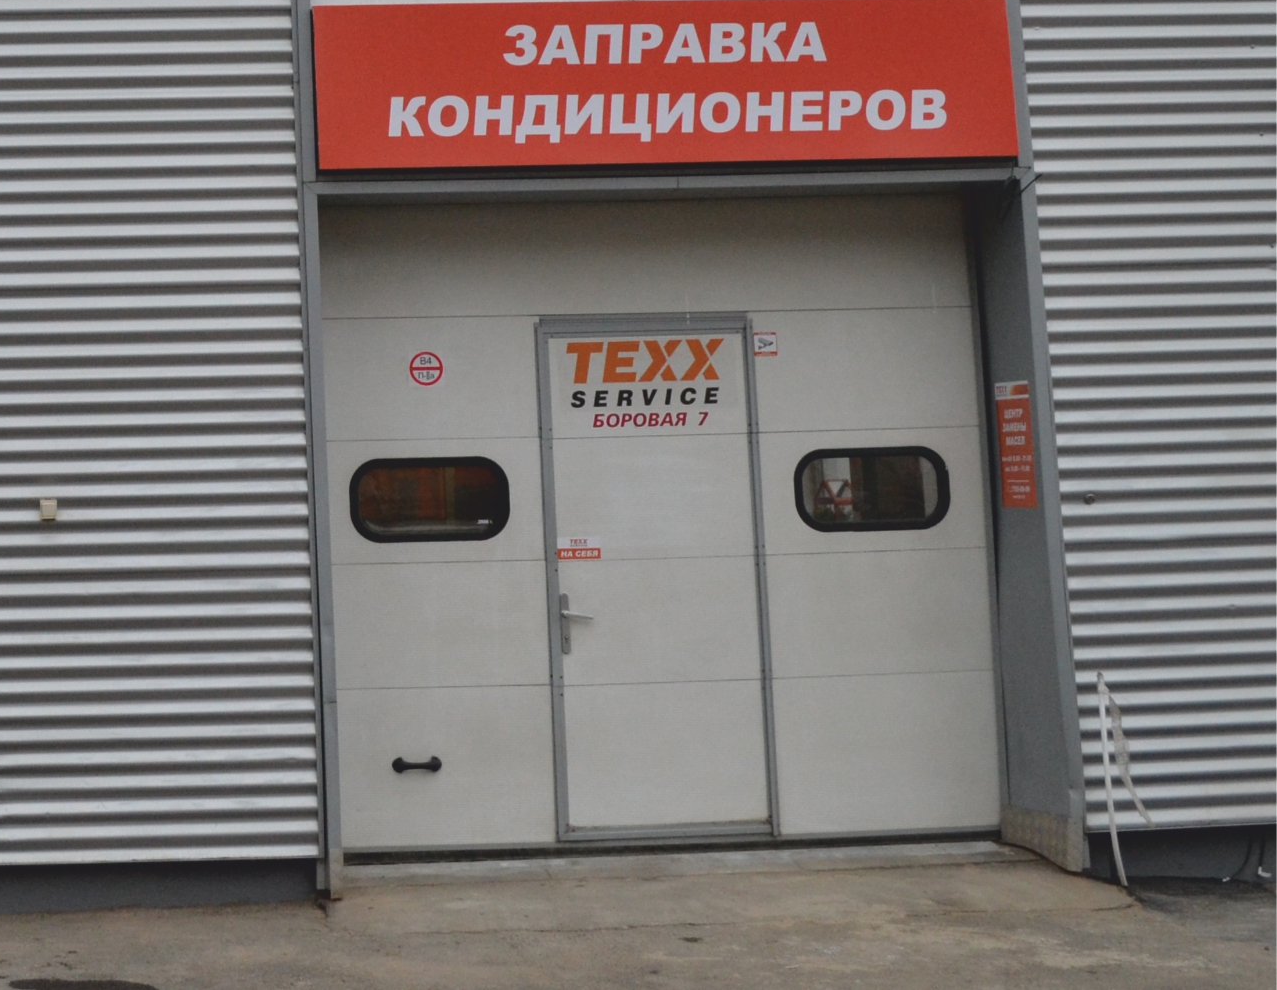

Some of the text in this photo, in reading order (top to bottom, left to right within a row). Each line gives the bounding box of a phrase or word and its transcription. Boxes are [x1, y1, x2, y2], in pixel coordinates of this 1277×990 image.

[503, 21, 827, 67] ЗАПРАВКА
[388, 89, 947, 144] КОНДИЦИОНЕРОВ
[566, 338, 724, 384] TEXX
[571, 387, 719, 408] SERVICE
[593, 412, 709, 428] БОРОВАЯ 7
